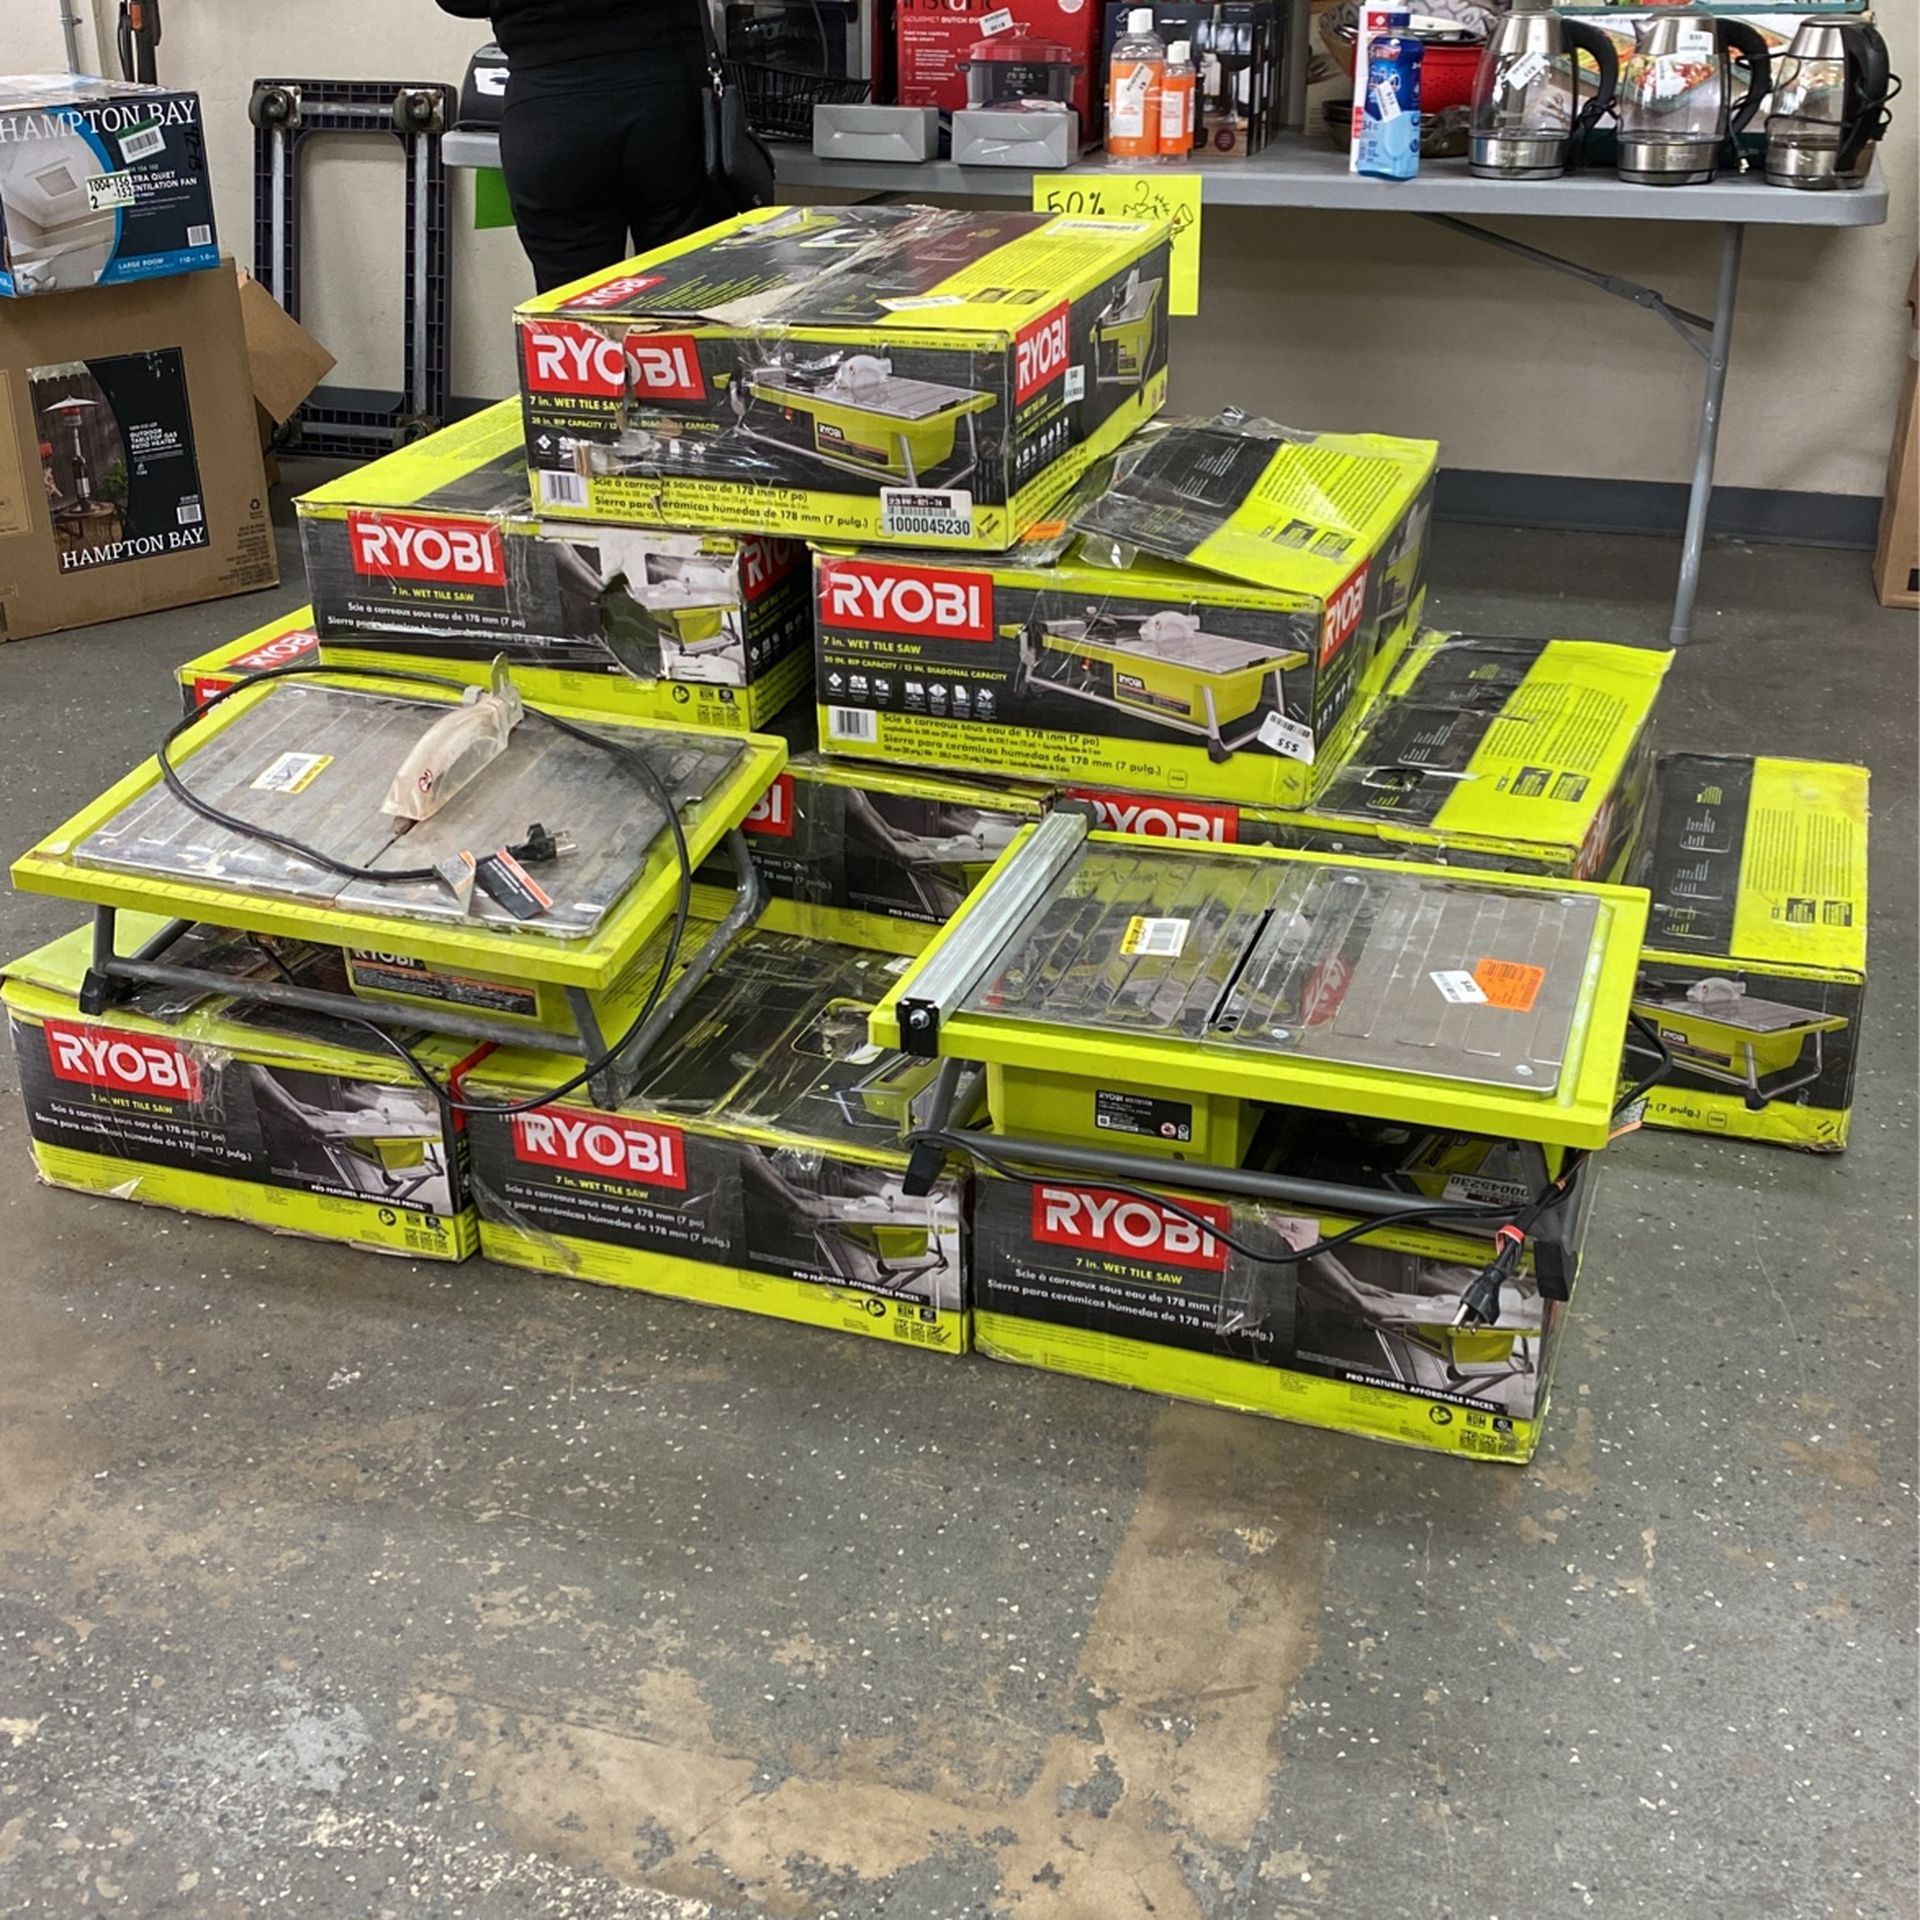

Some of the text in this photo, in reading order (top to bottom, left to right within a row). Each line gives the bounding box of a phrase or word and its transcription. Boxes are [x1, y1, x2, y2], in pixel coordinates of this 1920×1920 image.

[941, 16, 967, 24] DUTCH
[0, 100, 197, 143] HAMPTON BAY
[131, 177, 198, 193] ENTILATION FAN
[151, 171, 175, 180] QUIET
[90, 195, 99, 210] 2
[1047, 191, 1105, 215] 50%
[118, 259, 141, 270] LARGE
[142, 258, 165, 267] ROOM
[531, 334, 692, 388] RYOBI
[1018, 314, 1067, 391] RYOBI
[529, 395, 536, 405] 7
[554, 397, 577, 408] WET
[579, 399, 600, 410] TILE
[818, 424, 842, 439] RYOBI
[595, 496, 626, 507] Sierra
[629, 498, 654, 511] para
[658, 501, 709, 512] erámicas
[712, 503, 761, 517] húmedas
[764, 508, 777, 518] de
[780, 509, 798, 520] 178
[801, 513, 821, 523] mm
[824, 511, 834, 524] (7
[837, 514, 868, 528] pulg.)
[888, 516, 970, 536] 1000045230
[61, 527, 206, 569] HAMPTON BAY
[357, 523, 495, 574] RYOBI
[830, 572, 981, 628] RYOBI
[1324, 568, 1368, 653] RYOBI
[822, 636, 922, 655] 7 in. WET TILE SAW
[862, 659, 897, 670] CAPACITY
[927, 666, 969, 678] DIAGONAL
[971, 671, 1008, 681] CAPACITY
[883, 713, 902, 724] Scie
[914, 717, 958, 730] carreaux
[961, 723, 984, 733] sous
[986, 726, 1006, 735] eau
[1008, 728, 1021, 738] de
[1025, 729, 1044, 739] 178
[1069, 734, 1079, 745] (7
[1083, 737, 1100, 747] po)
[883, 733, 915, 745] Sierra
[917, 739, 943, 749] para
[945, 741, 998, 755] cerámicas
[1053, 753, 1066, 763] de
[1071, 756, 1089, 765] 178
[1092, 759, 1112, 769] mm
[1115, 760, 1127, 771] (7
[1130, 763, 1162, 776] pulg.)
[53, 1031, 191, 1090] RYOBI
[1655, 1103, 1702, 1119] (7 pulg.)
[518, 1112, 674, 1176] RYOBI
[555, 1175, 650, 1198] 7 in. WET TILE SAW
[504, 1184, 523, 1195] Scie
[534, 1189, 576, 1204] carreaux
[578, 1196, 599, 1208] sous
[601, 1201, 620, 1212] eau
[622, 1203, 634, 1214] de
[637, 1207, 654, 1218] 178
[656, 1213, 675, 1222] mm
[677, 1214, 687, 1226] (7
[688, 1218, 705, 1229] po)
[1042, 1188, 1216, 1258] RYOBI
[514, 1201, 537, 1212] para
[539, 1204, 586, 1221] cerámicas
[588, 1210, 632, 1229] húmedas
[634, 1220, 646, 1231] de
[649, 1224, 667, 1236] 178
[669, 1230, 688, 1240] mm
[690, 1231, 700, 1243] (7
[702, 1234, 731, 1249] pulg.)
[793, 1271, 808, 1280] PRO
[849, 1280, 893, 1297] AFFORDABLE
[1075, 1257, 1183, 1285] 7 in. WET TILE SAW
[1015, 1268, 1037, 1280] Scie
[1049, 1274, 1097, 1291] carreaux
[1099, 1283, 1122, 1296] sous
[1125, 1288, 1146, 1300] eau
[1149, 1291, 1163, 1303] de
[1166, 1295, 1186, 1308] 178
[1188, 1301, 1211, 1312] mm
[1212, 1304, 1223, 1316] (7
[987, 1279, 1019, 1293] Sierra
[1022, 1286, 1049, 1299] para
[1050, 1288, 1105, 1309] cerámicas
[1107, 1300, 1159, 1319] húmedas
[1161, 1310, 1176, 1322] de
[1178, 1314, 1199, 1327] 178
[1241, 1326, 1274, 1342] pulg.)
[1346, 1373, 1496, 1411] PRO FEATURES. AFFORDABLE PRICES.
